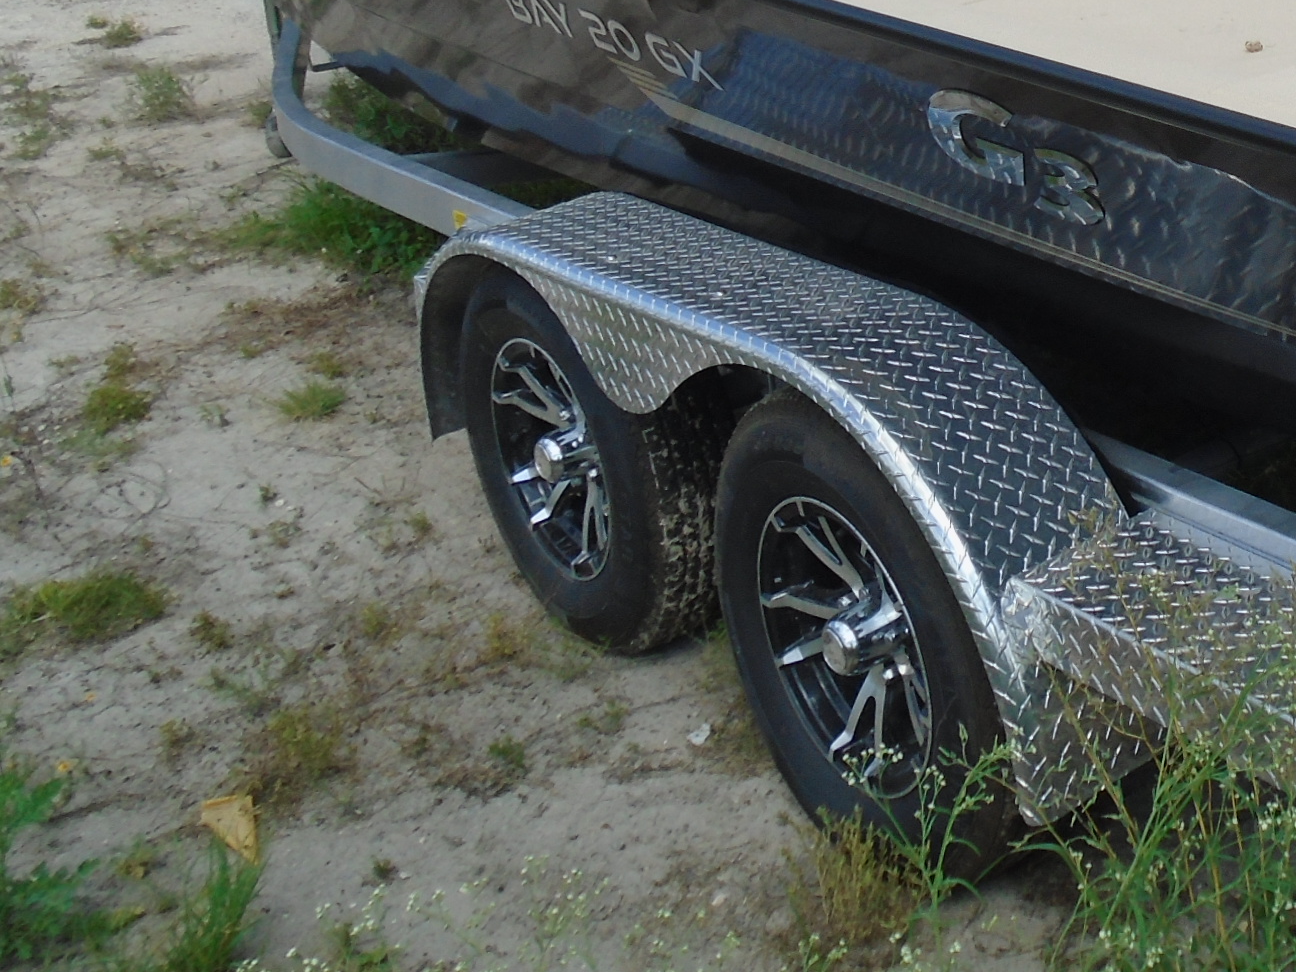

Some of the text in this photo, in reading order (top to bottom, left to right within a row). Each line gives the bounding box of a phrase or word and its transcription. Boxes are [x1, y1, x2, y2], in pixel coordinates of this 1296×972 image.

[577, 8, 642, 62] 20
[645, 31, 725, 92] GX
[927, 88, 1106, 227] G3
